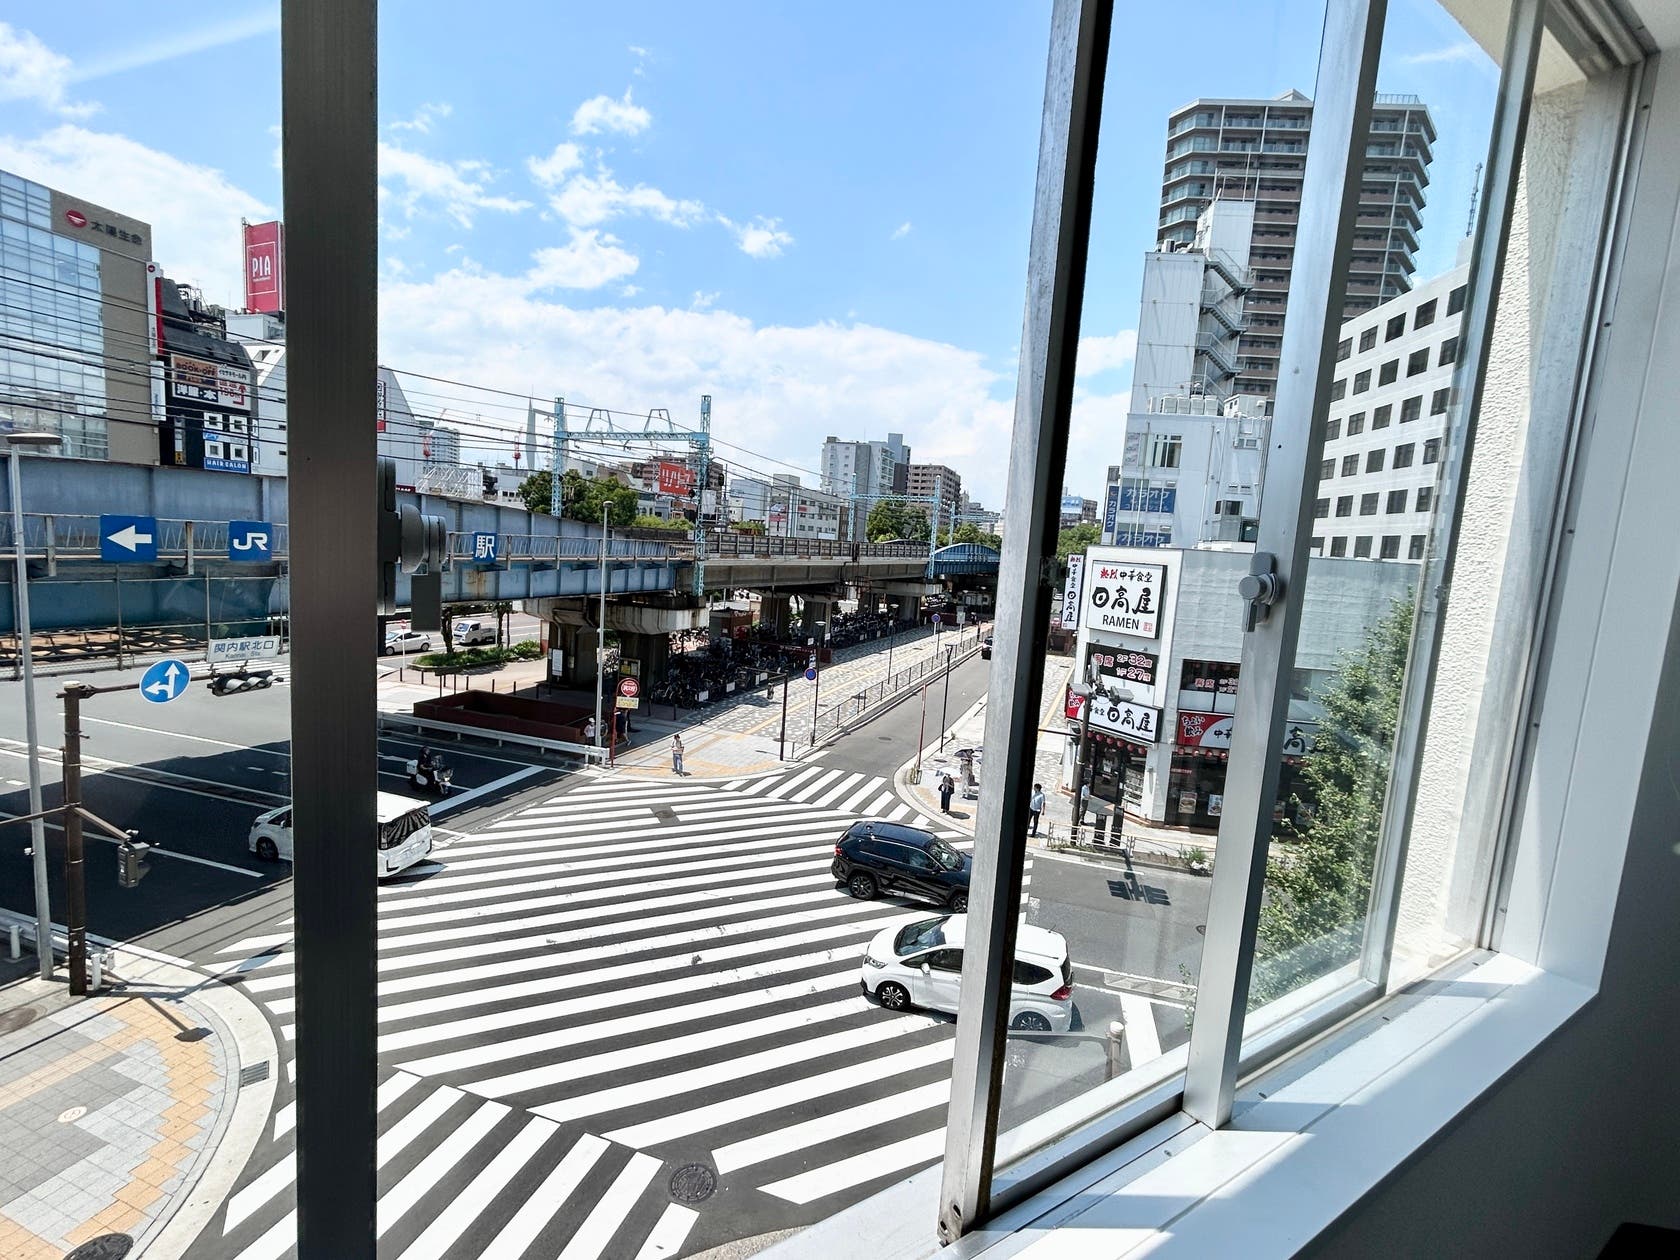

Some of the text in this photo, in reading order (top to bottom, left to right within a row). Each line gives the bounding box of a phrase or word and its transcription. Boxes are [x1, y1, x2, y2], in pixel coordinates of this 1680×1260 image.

[252, 255, 271, 278] PIA
[206, 459, 247, 469] HAIR SALON
[233, 532, 268, 550] JR
[475, 535, 495, 559] 駅
[1092, 584, 1155, 615] 日高屋
[1102, 614, 1140, 630] RAMEN
[214, 640, 274, 653] 関内駅北口
[1107, 706, 1153, 733] 日高屋
